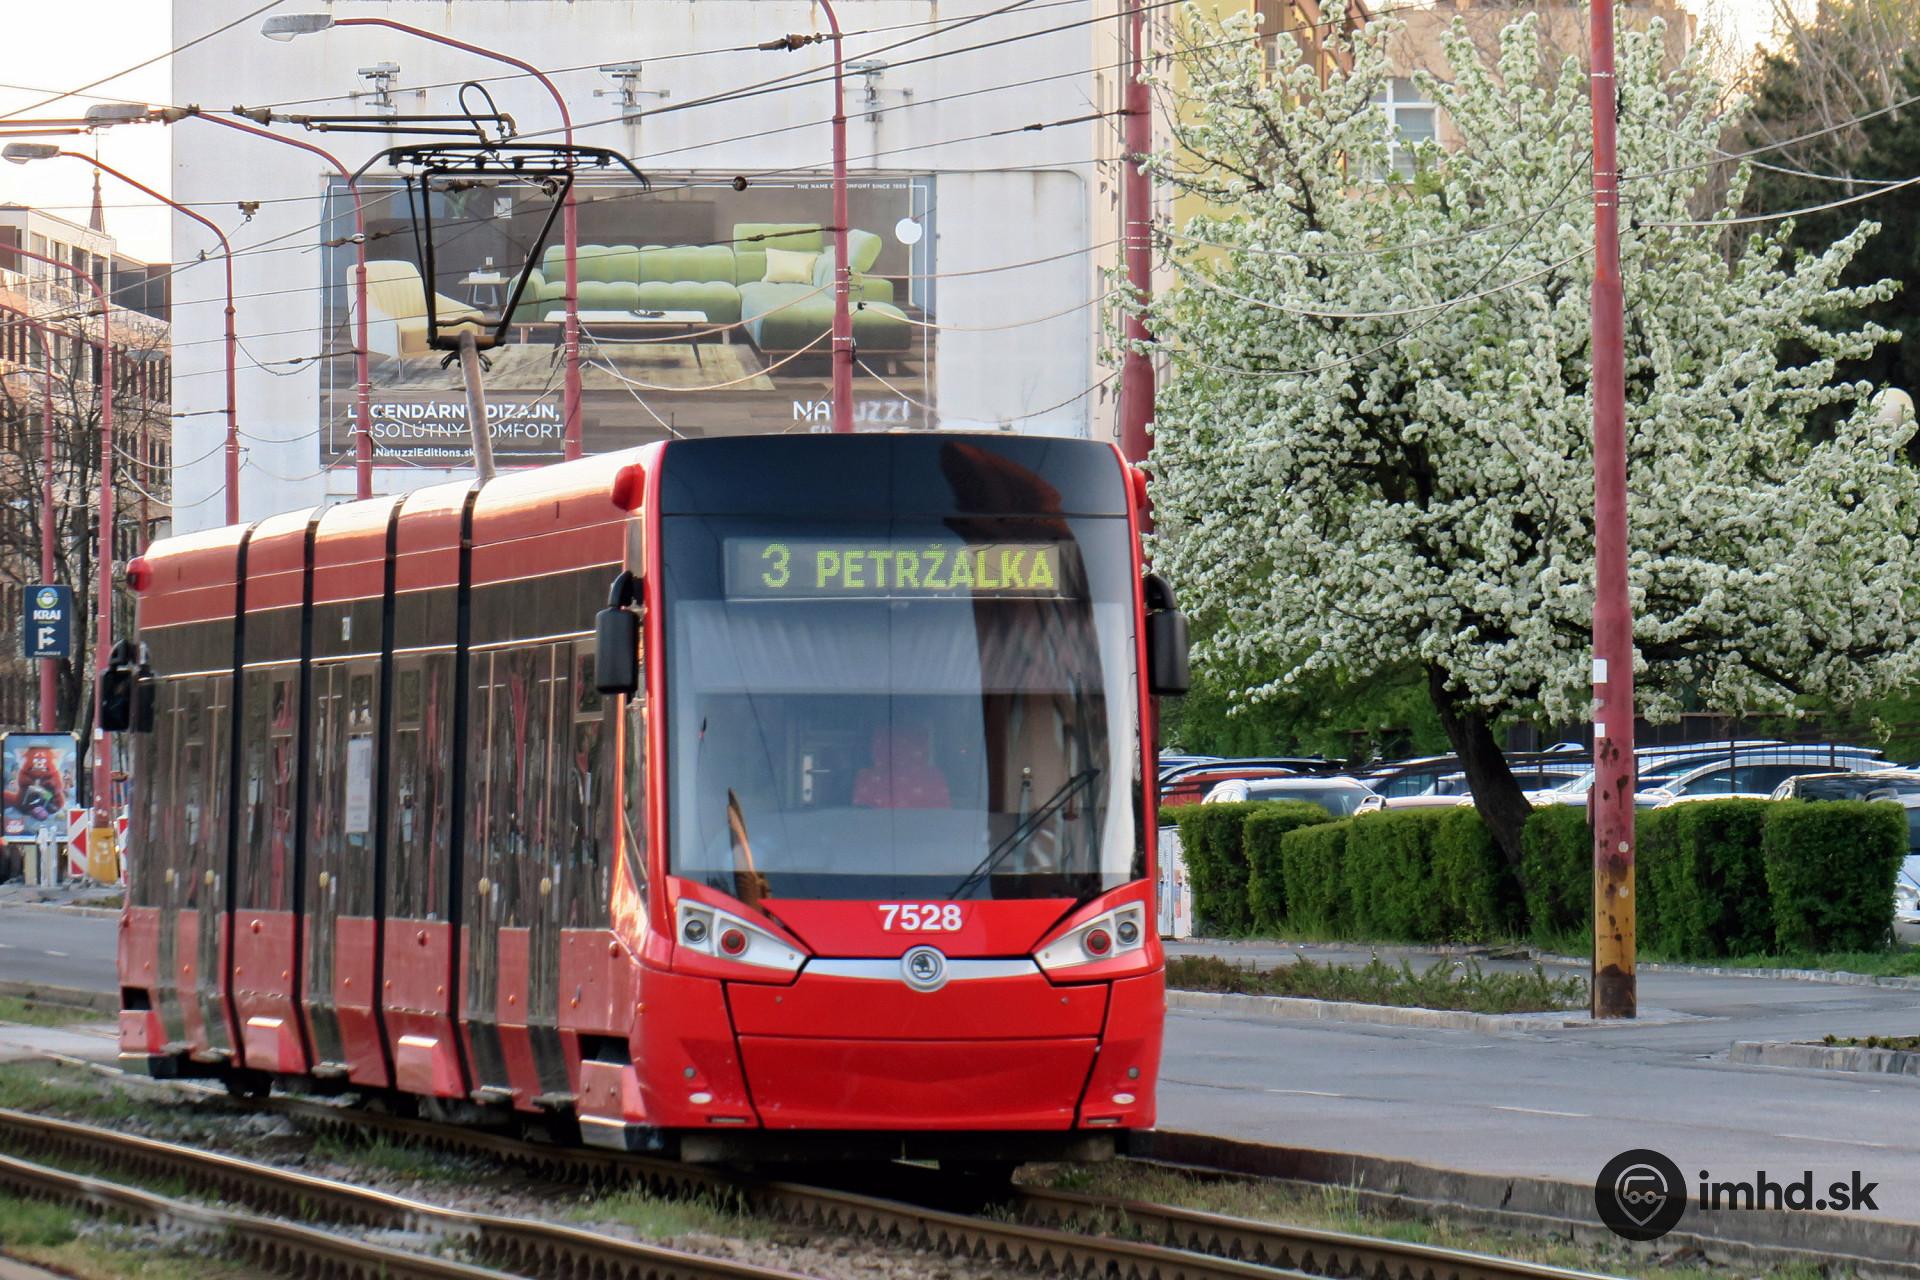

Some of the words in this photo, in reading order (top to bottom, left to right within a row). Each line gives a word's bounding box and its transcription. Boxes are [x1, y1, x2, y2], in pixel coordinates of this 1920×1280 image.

[347, 401, 468, 419] LGENDÁRN
[793, 400, 909, 421] NAUZZI
[488, 423, 563, 438] OMFORT
[347, 448, 475, 457] w.NatuzziEditions.sk
[762, 543, 792, 588] 3
[816, 543, 1054, 588] PETRŽALKA
[878, 904, 963, 931] 7528
